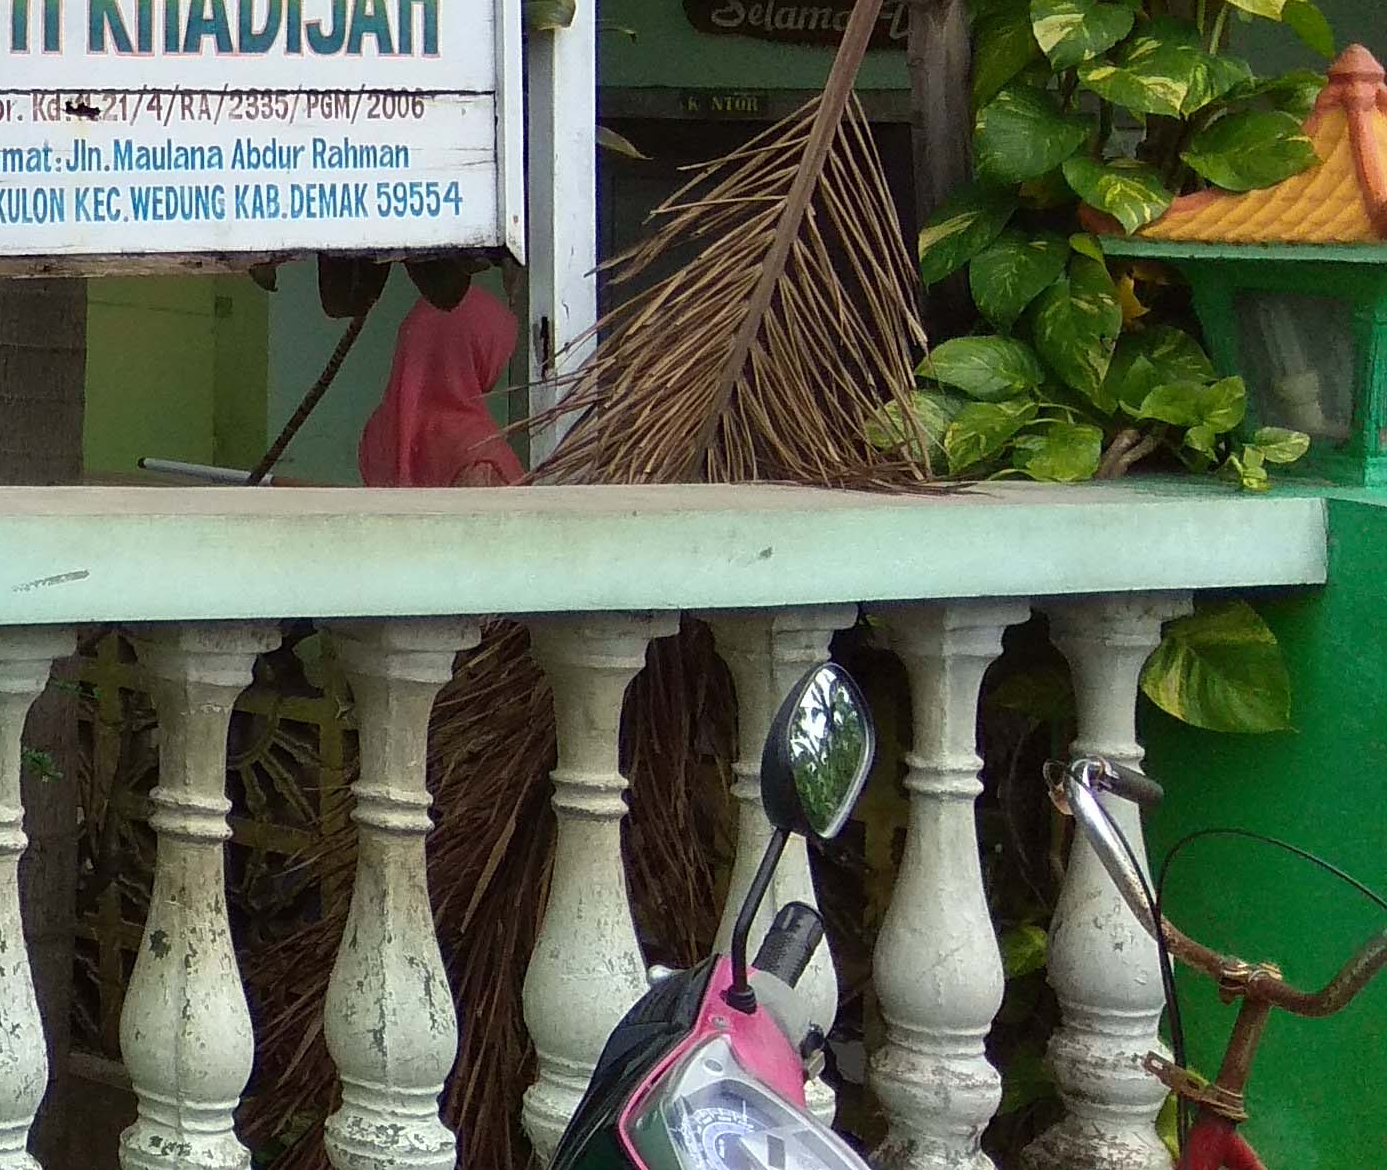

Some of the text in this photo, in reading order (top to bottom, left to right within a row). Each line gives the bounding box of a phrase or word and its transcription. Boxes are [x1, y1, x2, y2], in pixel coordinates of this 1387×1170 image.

[687, 94, 760, 112] KNTOR
[230, 137, 305, 170] Abdur
[312, 137, 410, 170] Rahman
[376, 180, 463, 218] 59554
